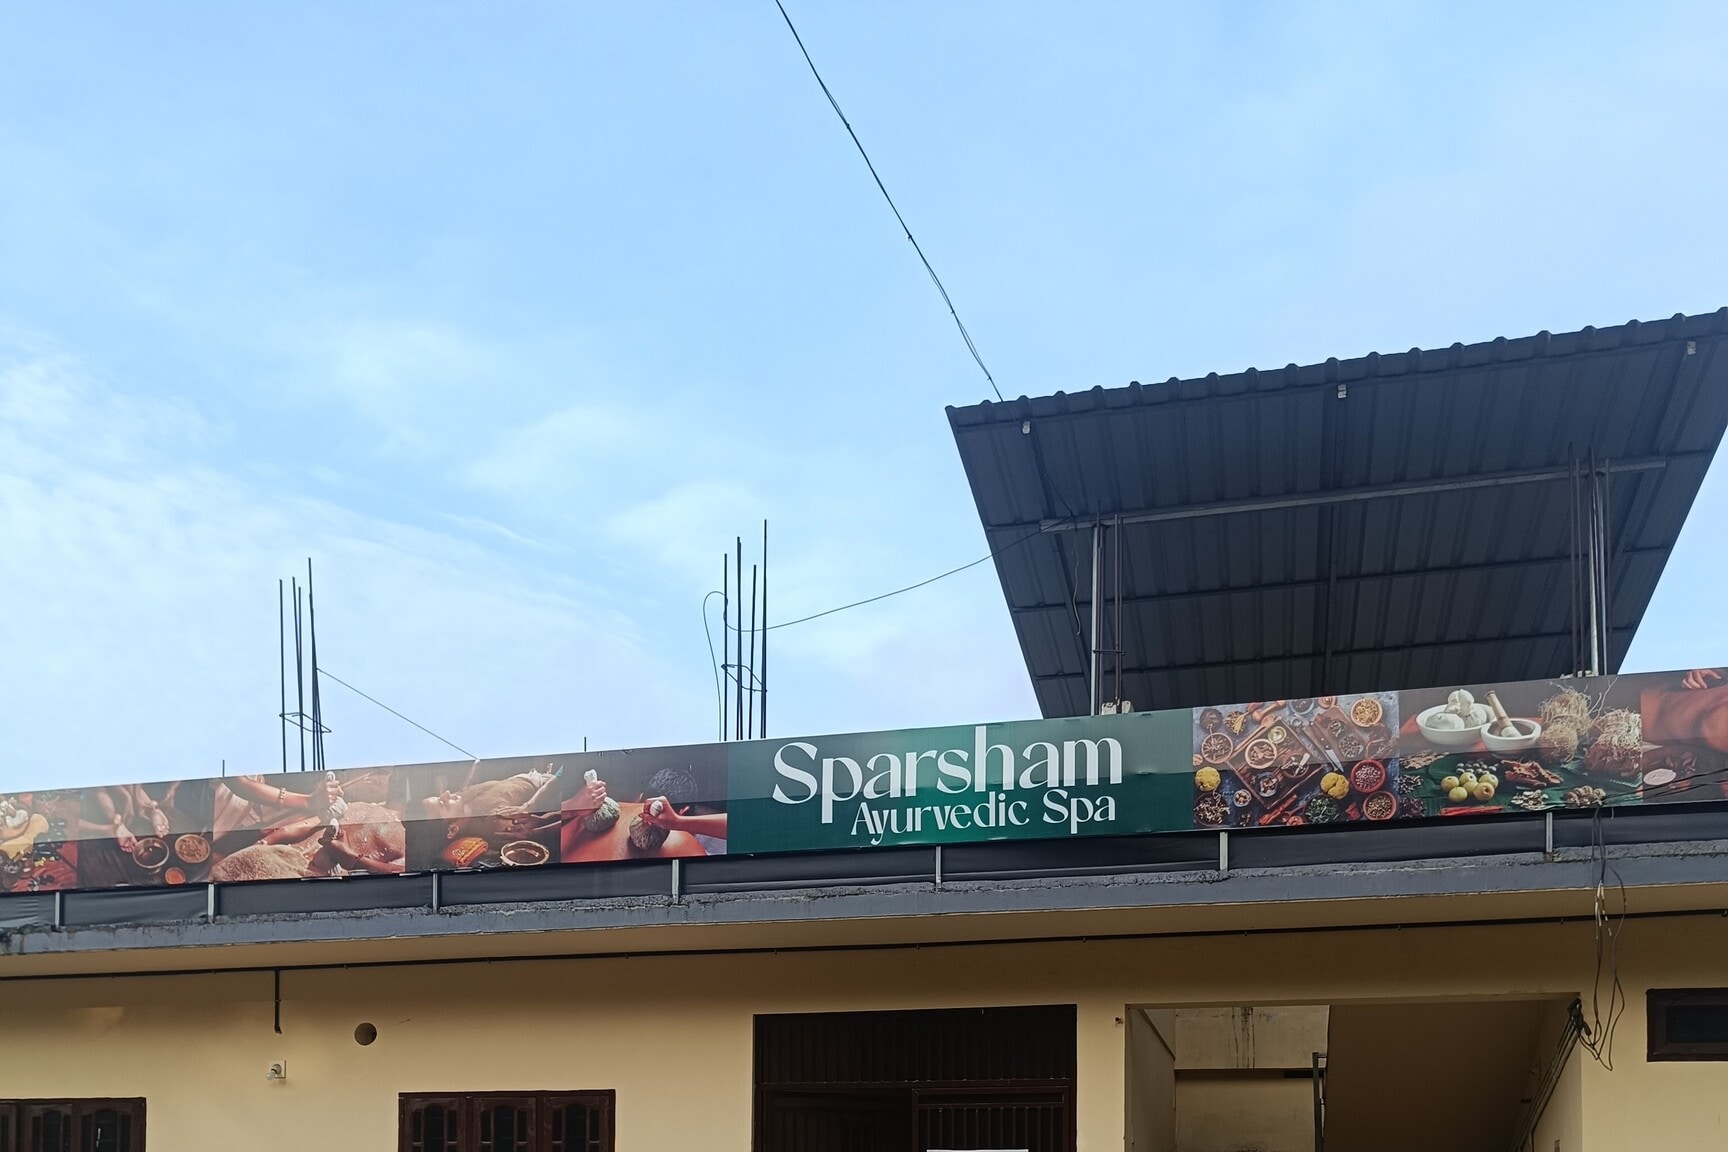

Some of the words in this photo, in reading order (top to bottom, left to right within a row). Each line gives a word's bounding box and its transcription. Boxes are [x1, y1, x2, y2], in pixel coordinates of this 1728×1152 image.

[772, 726, 1122, 824] Sparsham
[850, 792, 1030, 846] Ayurvedic
[1042, 789, 1116, 835] Spa
